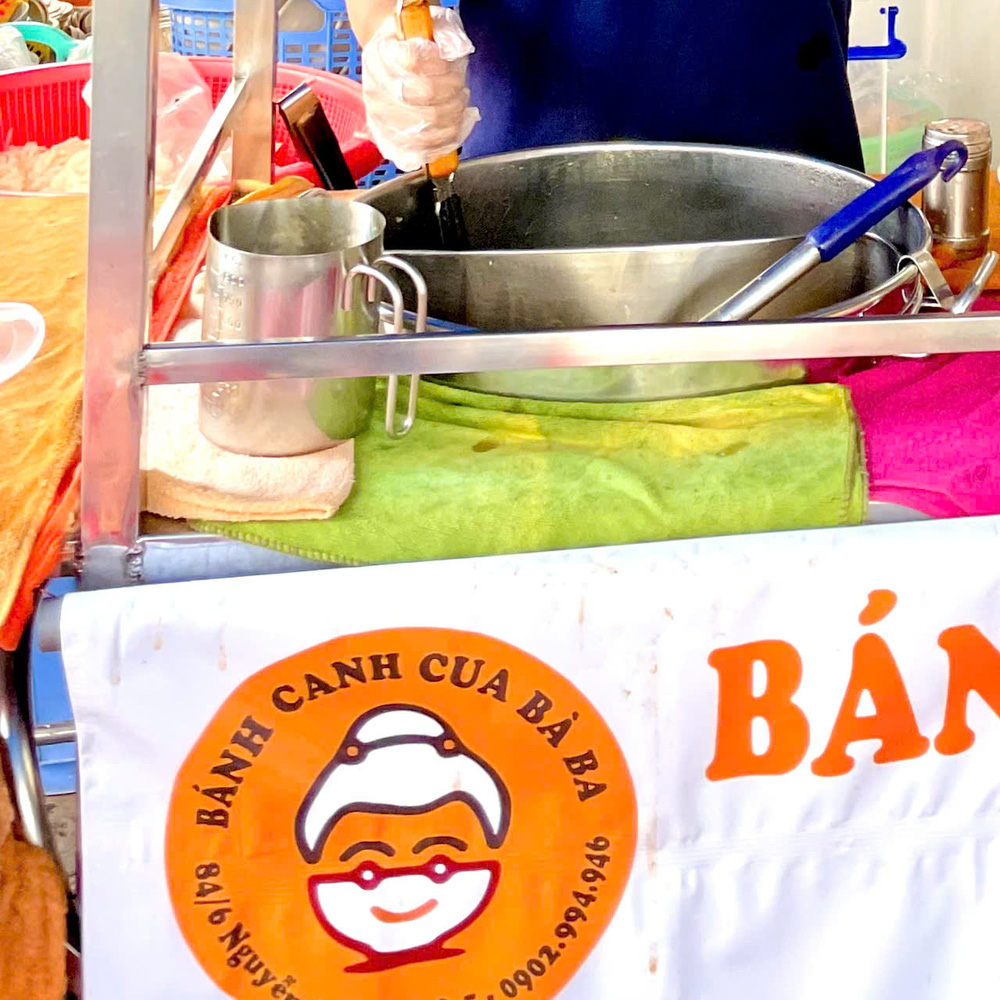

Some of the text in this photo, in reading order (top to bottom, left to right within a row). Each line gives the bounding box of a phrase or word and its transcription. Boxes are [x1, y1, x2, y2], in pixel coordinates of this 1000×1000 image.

[192, 652, 609, 829] BÁNH CANH CUA BÀ BA
[499, 836, 611, 998] 0902.994.946
